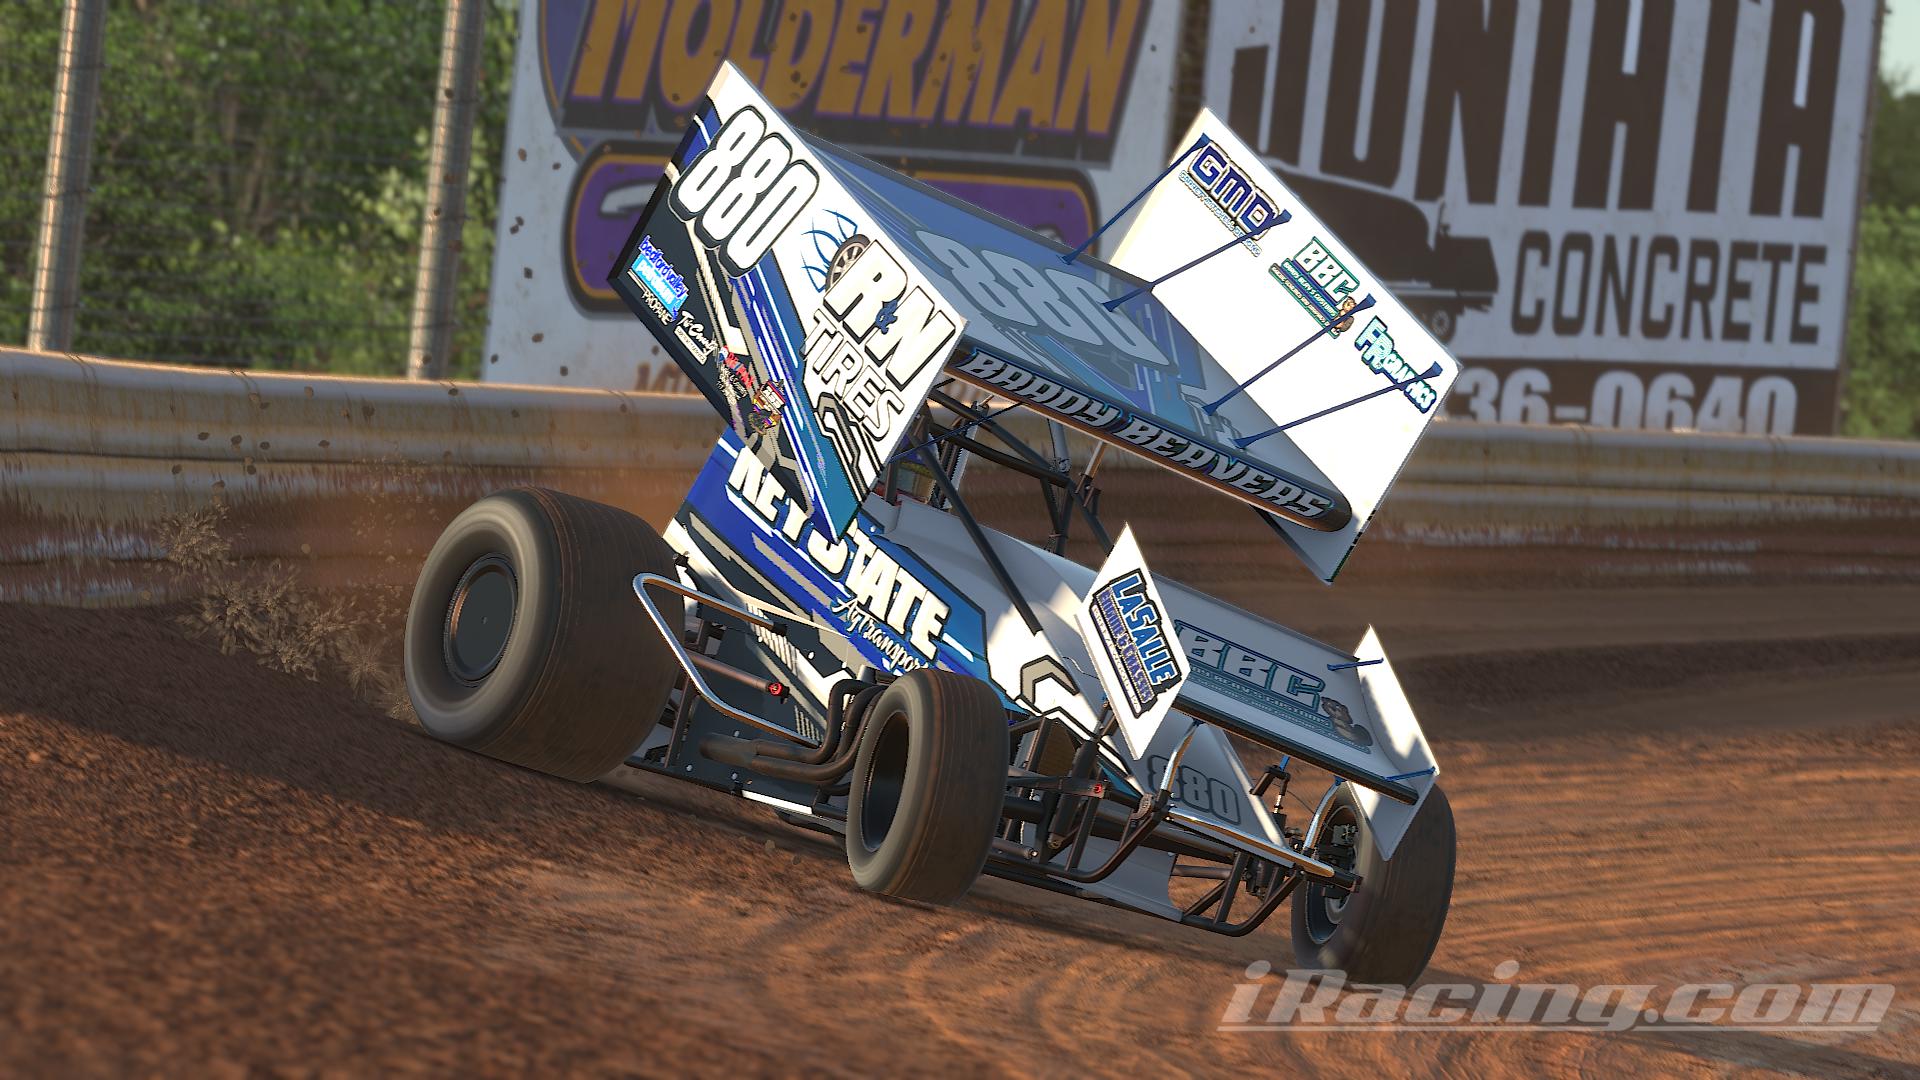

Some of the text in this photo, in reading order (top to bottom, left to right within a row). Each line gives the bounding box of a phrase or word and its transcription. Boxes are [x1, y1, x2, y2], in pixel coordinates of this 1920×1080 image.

[1227, 0, 1845, 218] JUNIATA
[670, 106, 819, 277] 880
[915, 231, 1170, 366] 880
[1510, 230, 1827, 345] CONCRETE
[803, 308, 905, 441] TIRES
[1116, 413, 1331, 519] BEAVERS
[836, 597, 930, 671] AgTranspor
[1111, 573, 1178, 686] LASALLE
